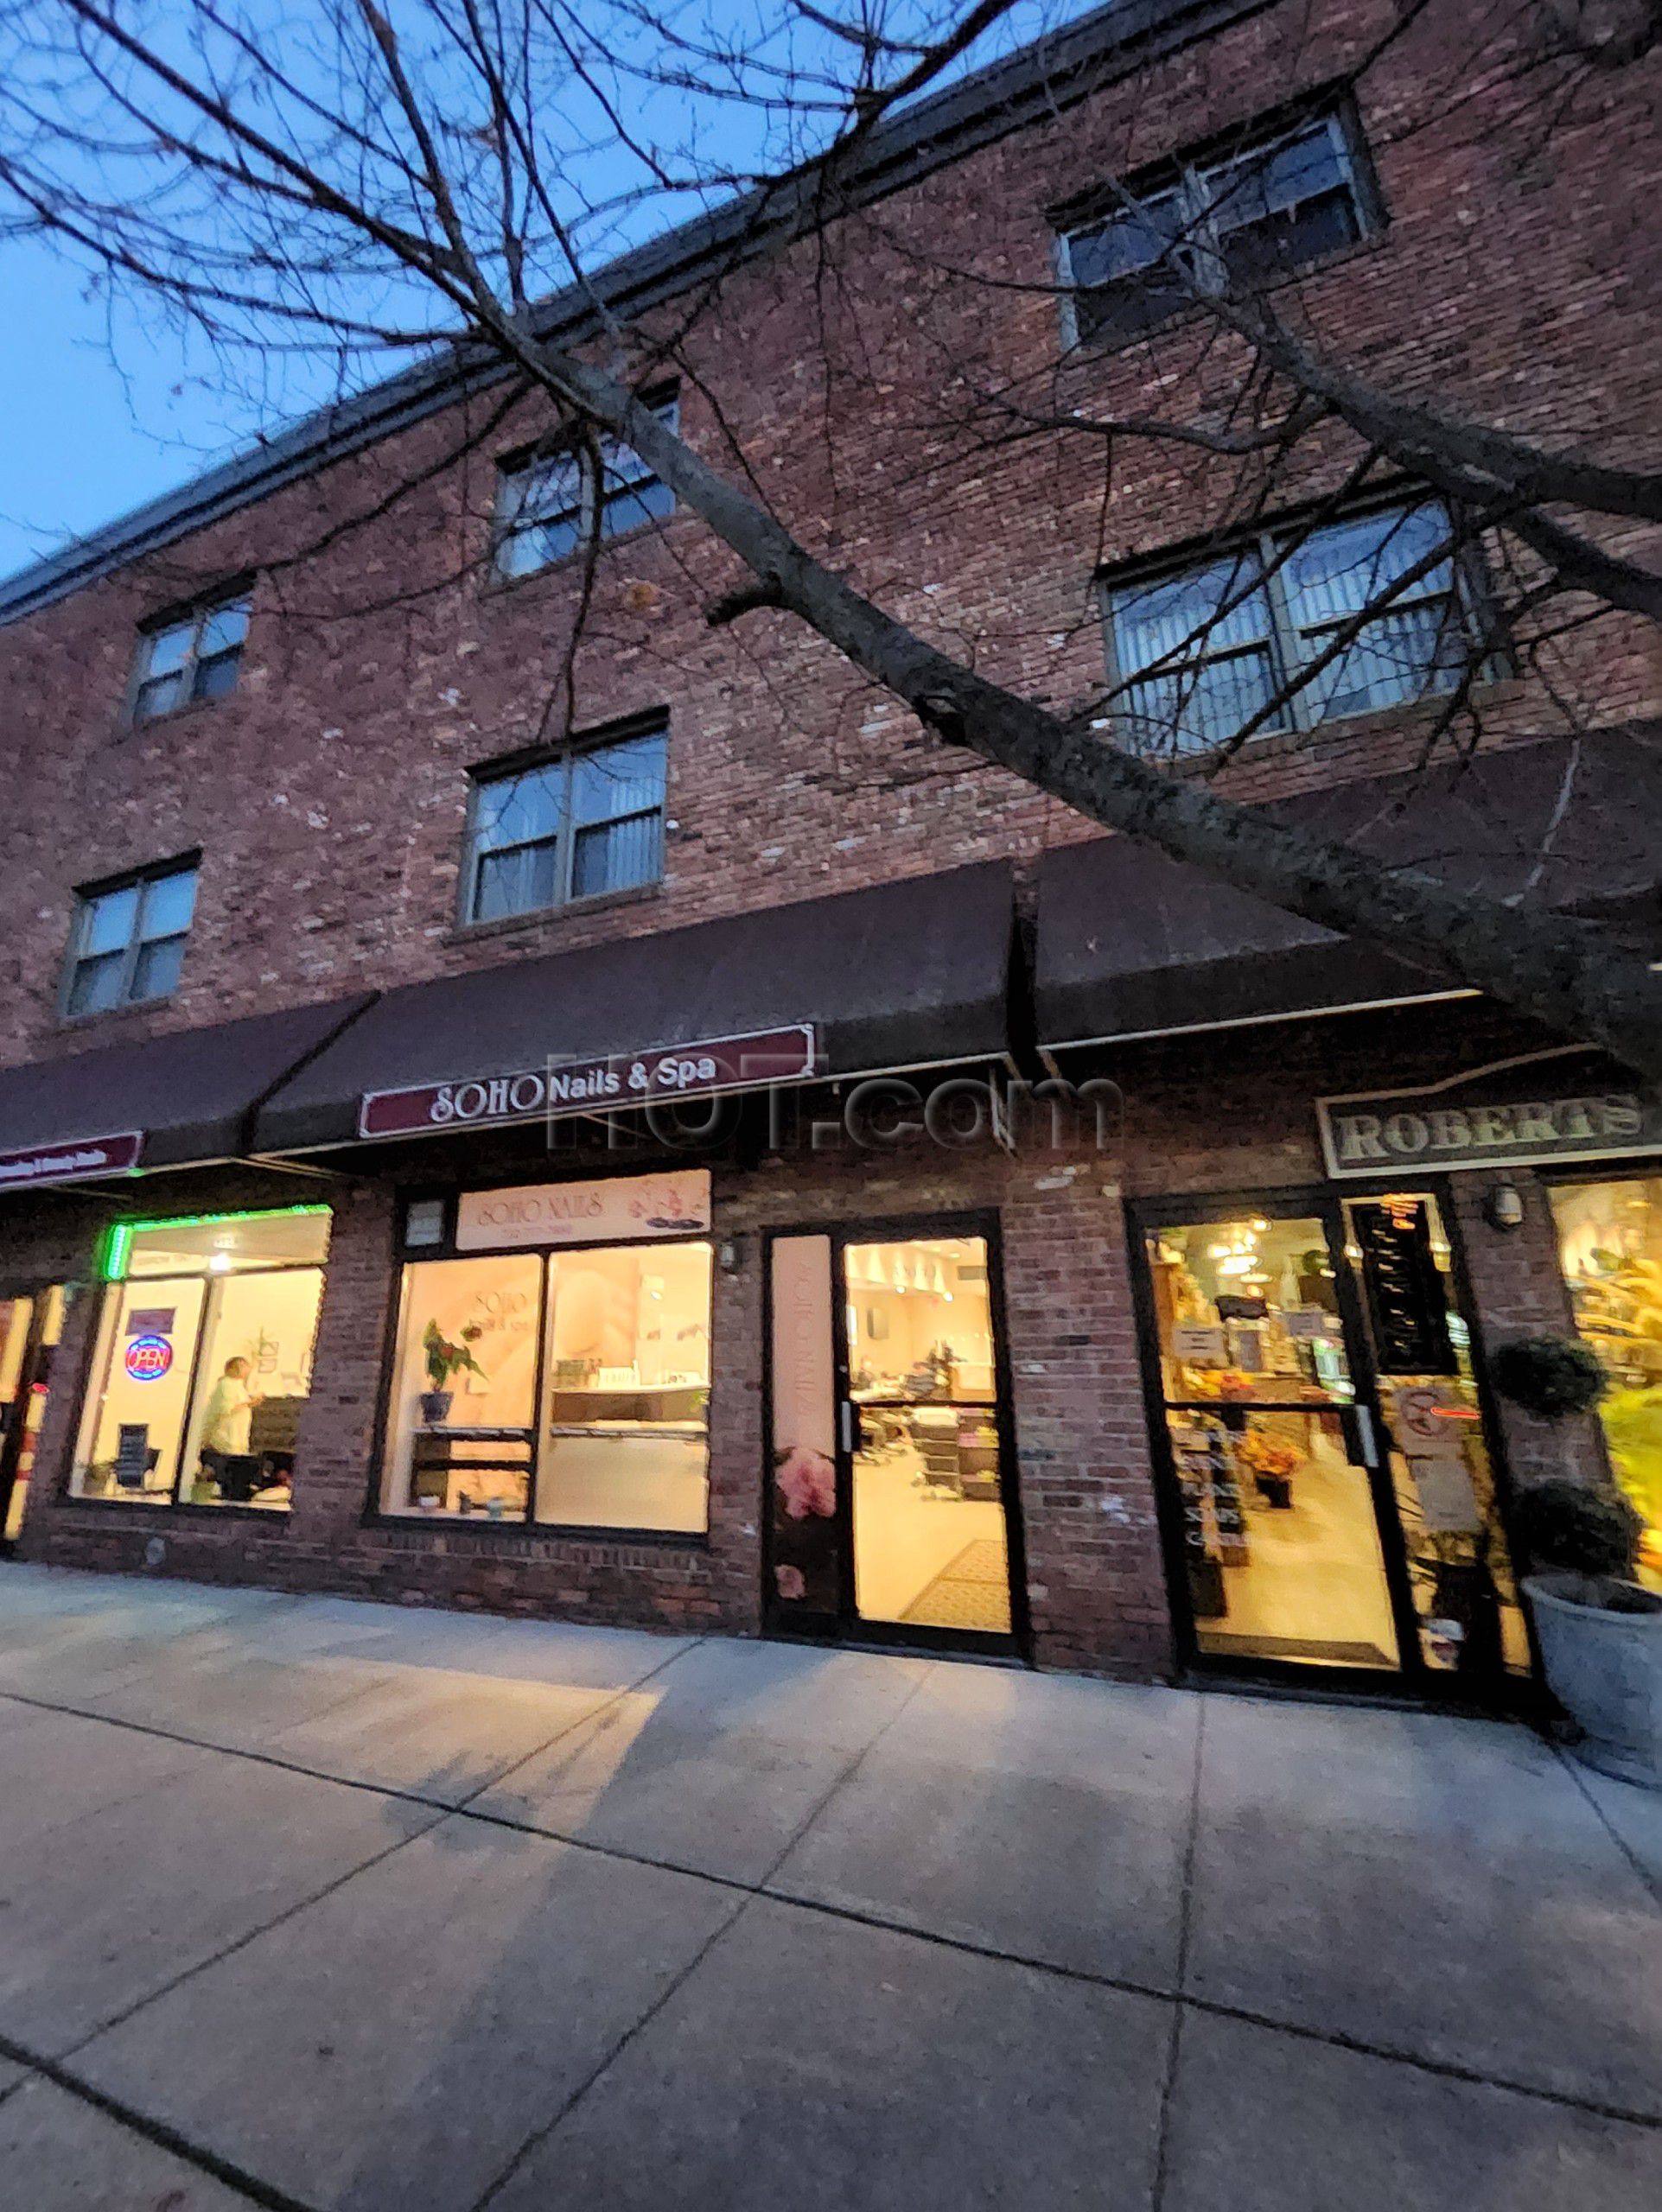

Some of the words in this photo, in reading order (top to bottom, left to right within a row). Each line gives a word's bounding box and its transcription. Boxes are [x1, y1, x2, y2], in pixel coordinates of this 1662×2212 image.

[430, 1075, 544, 1123] SOHO
[548, 1069, 621, 1101] Nails
[627, 1062, 648, 1090] &
[656, 1056, 717, 1093] Spa
[1334, 1093, 1642, 1160] ROBERTS
[127, 1348, 167, 1370] OPEN
